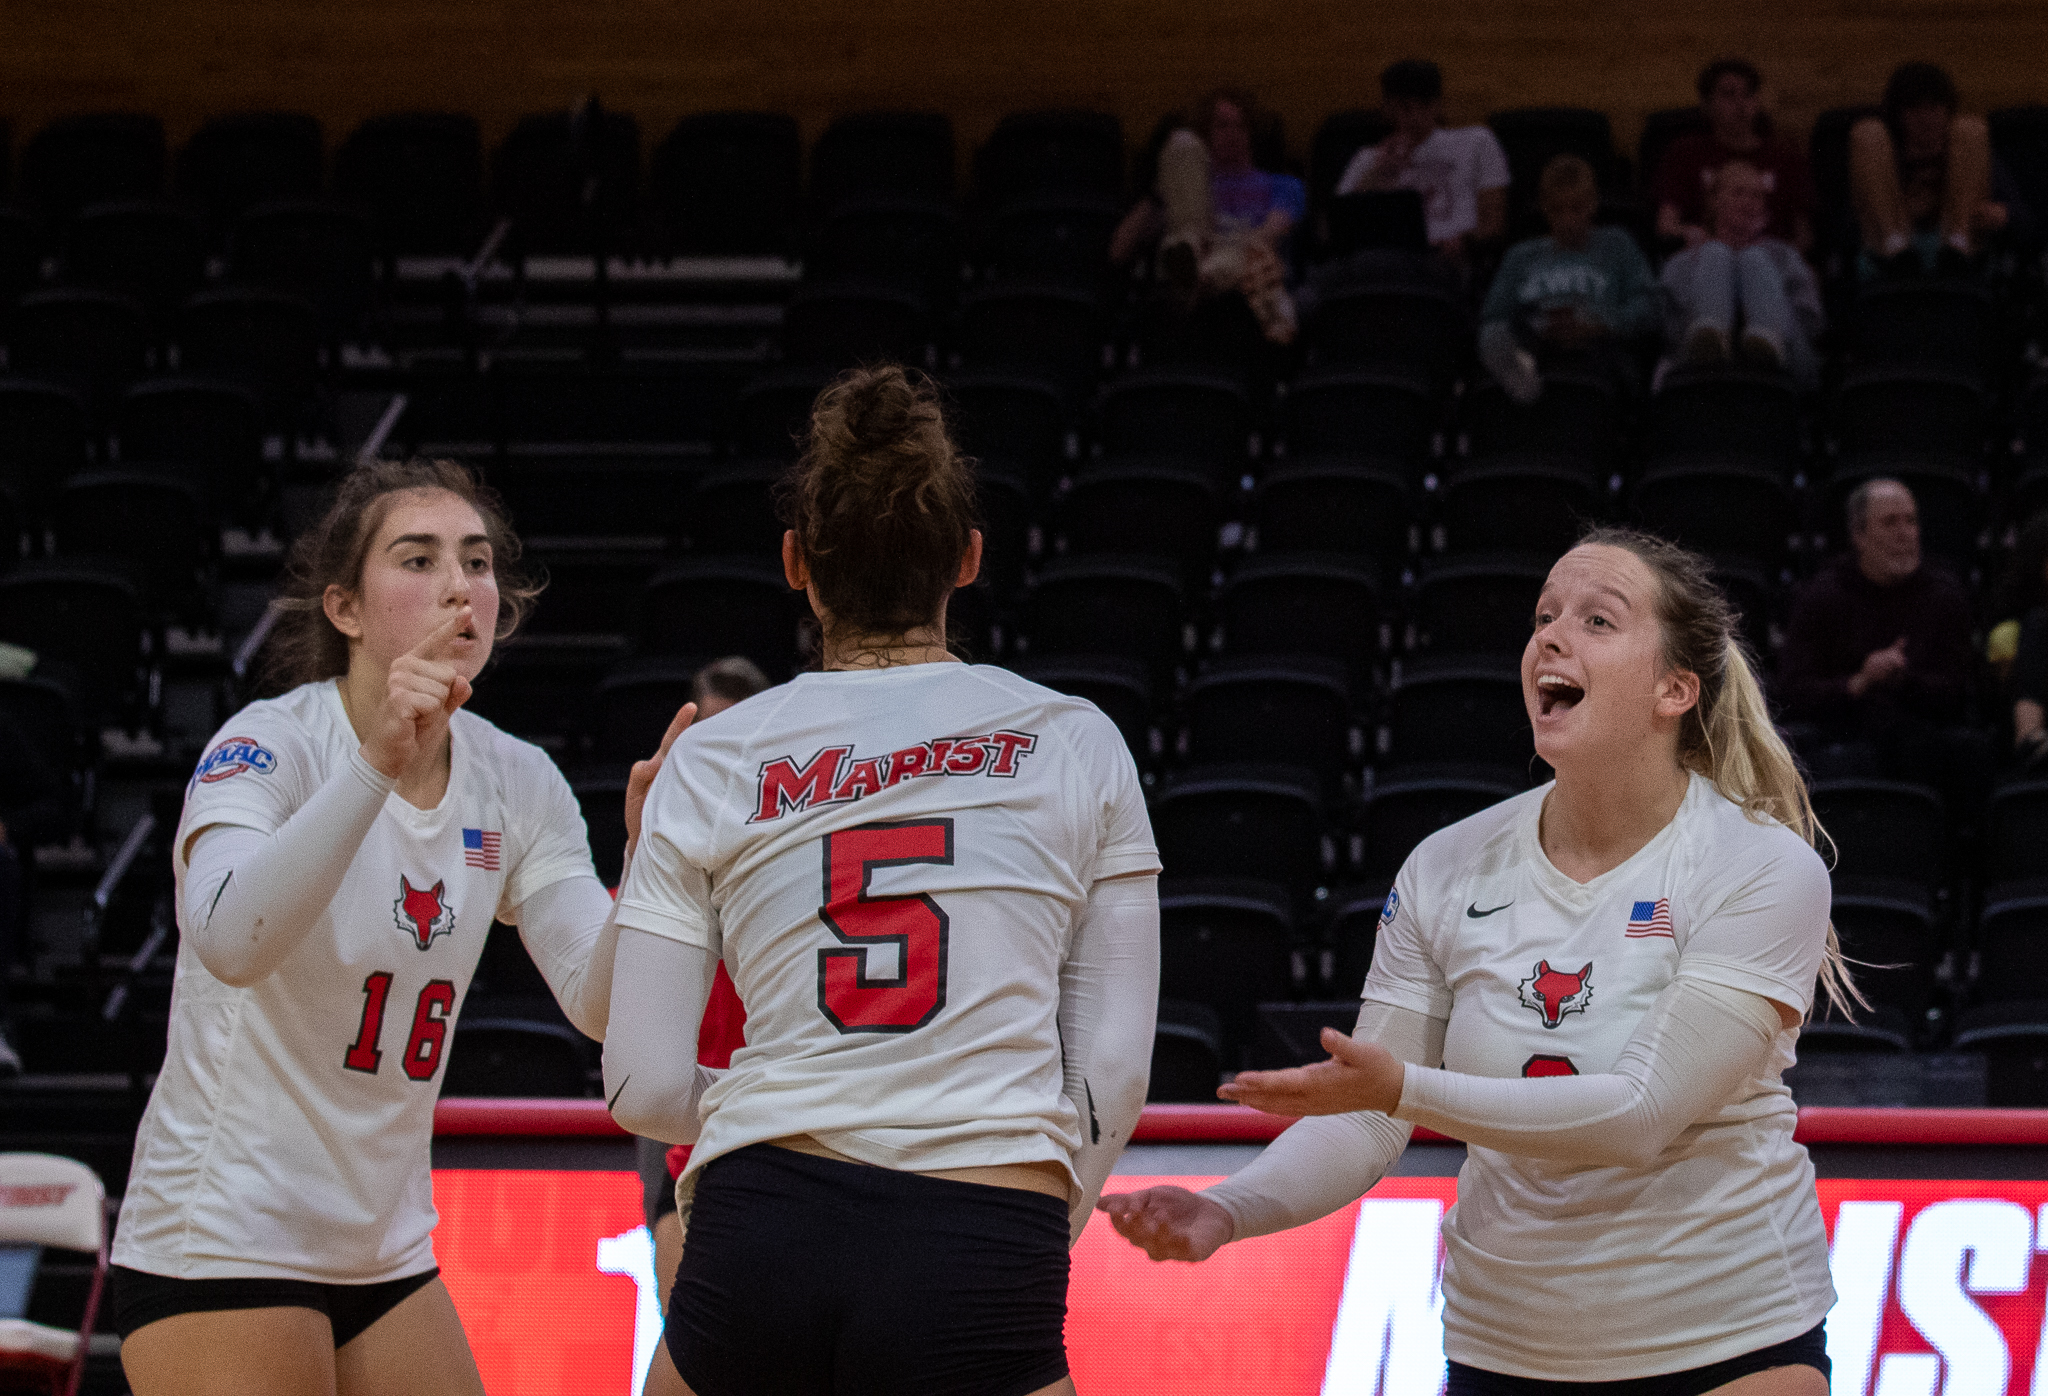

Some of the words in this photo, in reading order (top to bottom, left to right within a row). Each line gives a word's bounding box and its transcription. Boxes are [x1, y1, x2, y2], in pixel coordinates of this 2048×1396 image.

[746, 729, 1038, 825] MARIST
[817, 818, 954, 1035] 5
[343, 970, 456, 1082] 16
